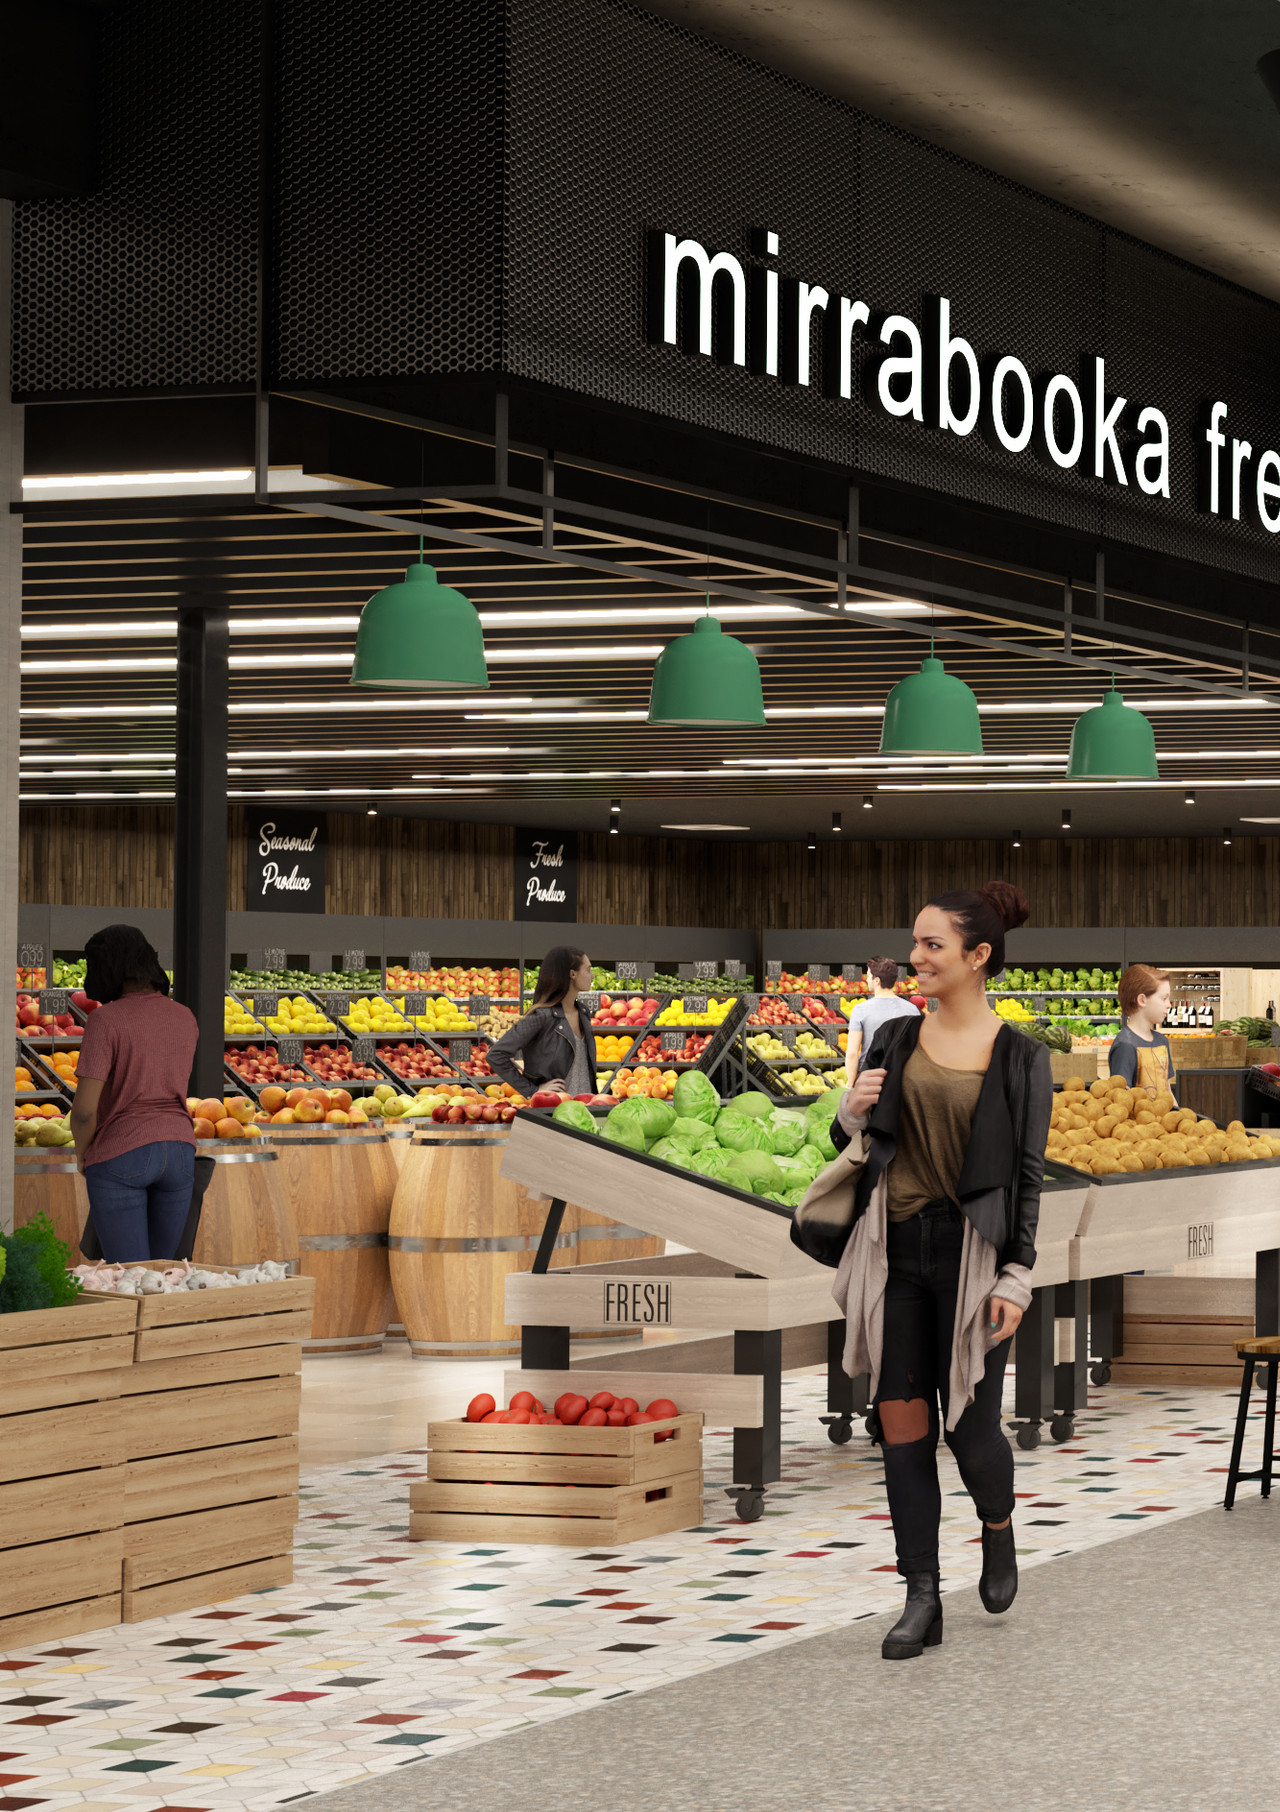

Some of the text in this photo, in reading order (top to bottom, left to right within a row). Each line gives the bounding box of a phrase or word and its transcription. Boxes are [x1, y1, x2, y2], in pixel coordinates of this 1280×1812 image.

[662, 230, 1171, 499] mirrabooka
[258, 821, 319, 857] Seasonal
[529, 840, 564, 869] Fresh
[261, 861, 312, 896] Produce
[525, 876, 567, 907] Produce
[264, 948, 286, 956] LEMONS
[344, 949, 365, 957] LEMONS
[40, 990, 66, 998] ORANGES
[44, 998, 67, 1015] 1.99
[282, 1047, 302, 1063] 3.99
[1188, 1224, 1213, 1258] FRESH
[606, 1283, 669, 1323] FRESH
